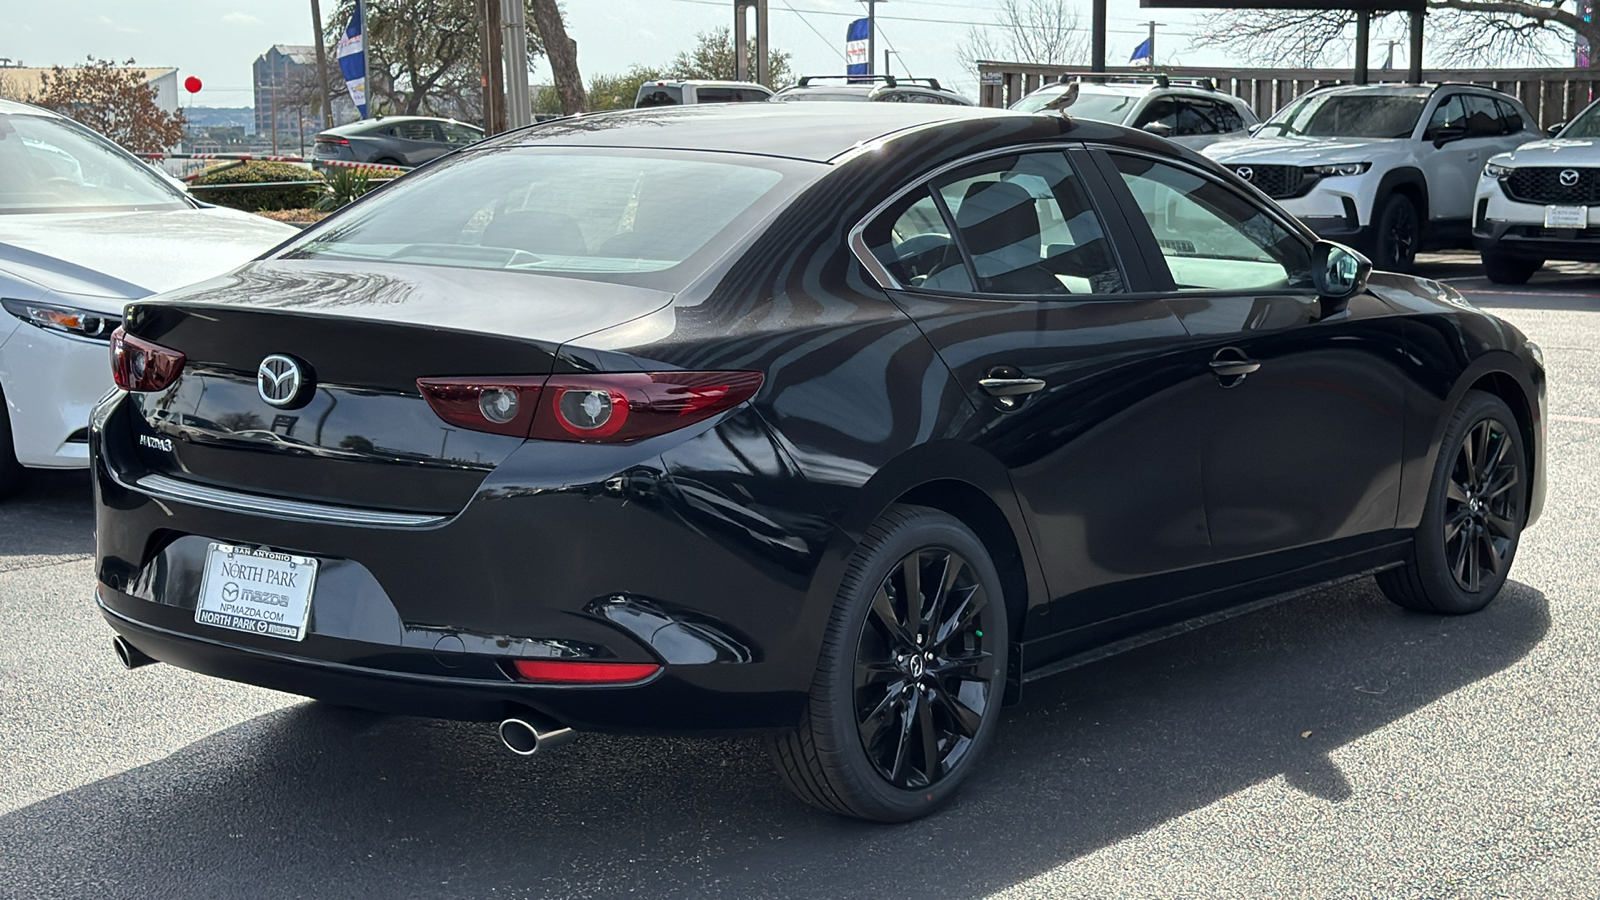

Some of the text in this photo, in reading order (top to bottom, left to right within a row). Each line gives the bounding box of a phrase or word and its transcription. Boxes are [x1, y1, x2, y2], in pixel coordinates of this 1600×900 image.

[140, 434, 172, 452] MAZDA3
[233, 547, 290, 562] SAN ANTONIO
[221, 561, 298, 588] NORTH PARK
[241, 588, 289, 608] mazda
[220, 603, 285, 622] NPMAZDA.COM
[201, 611, 297, 637] NORTH PARK mazda
